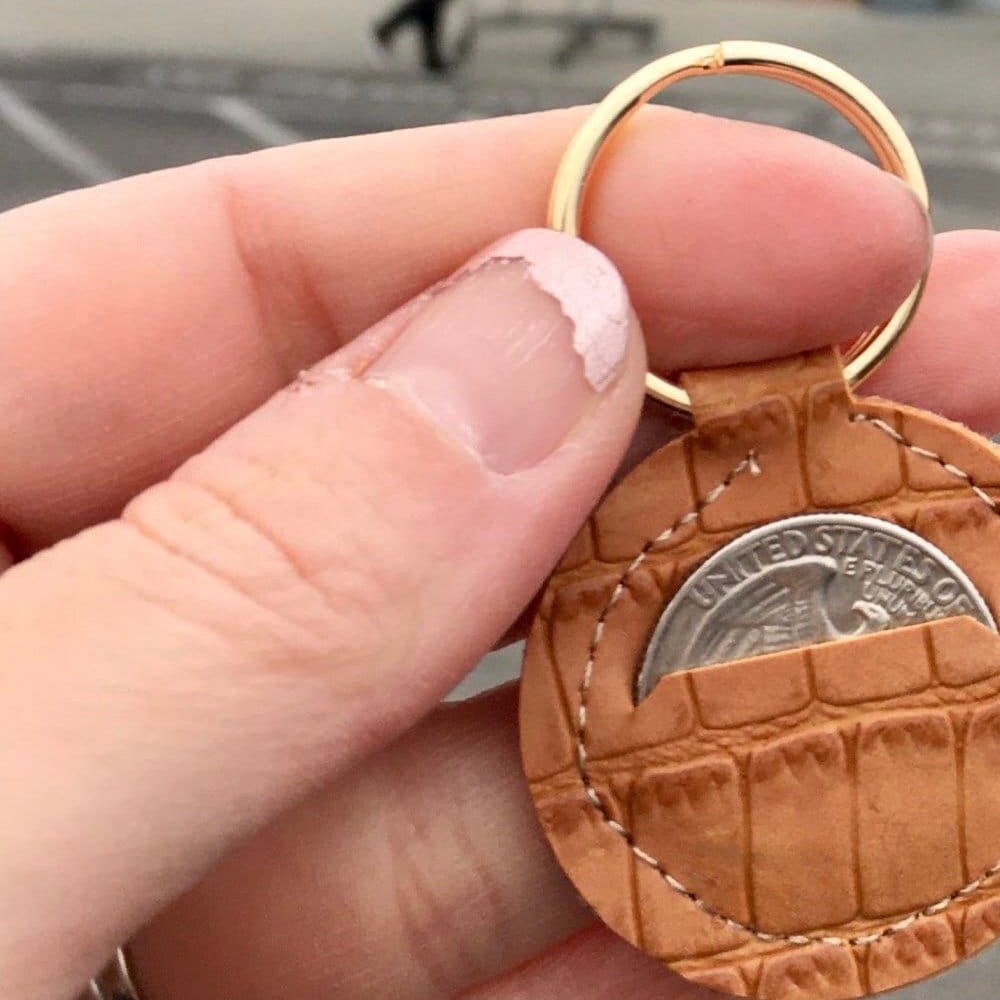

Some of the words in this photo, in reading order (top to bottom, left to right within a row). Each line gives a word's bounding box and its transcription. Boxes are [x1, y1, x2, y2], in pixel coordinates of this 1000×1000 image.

[691, 529, 807, 610] UNITED
[813, 525, 938, 584] STATES
[932, 577, 976, 613] OF
[843, 556, 858, 576] E
